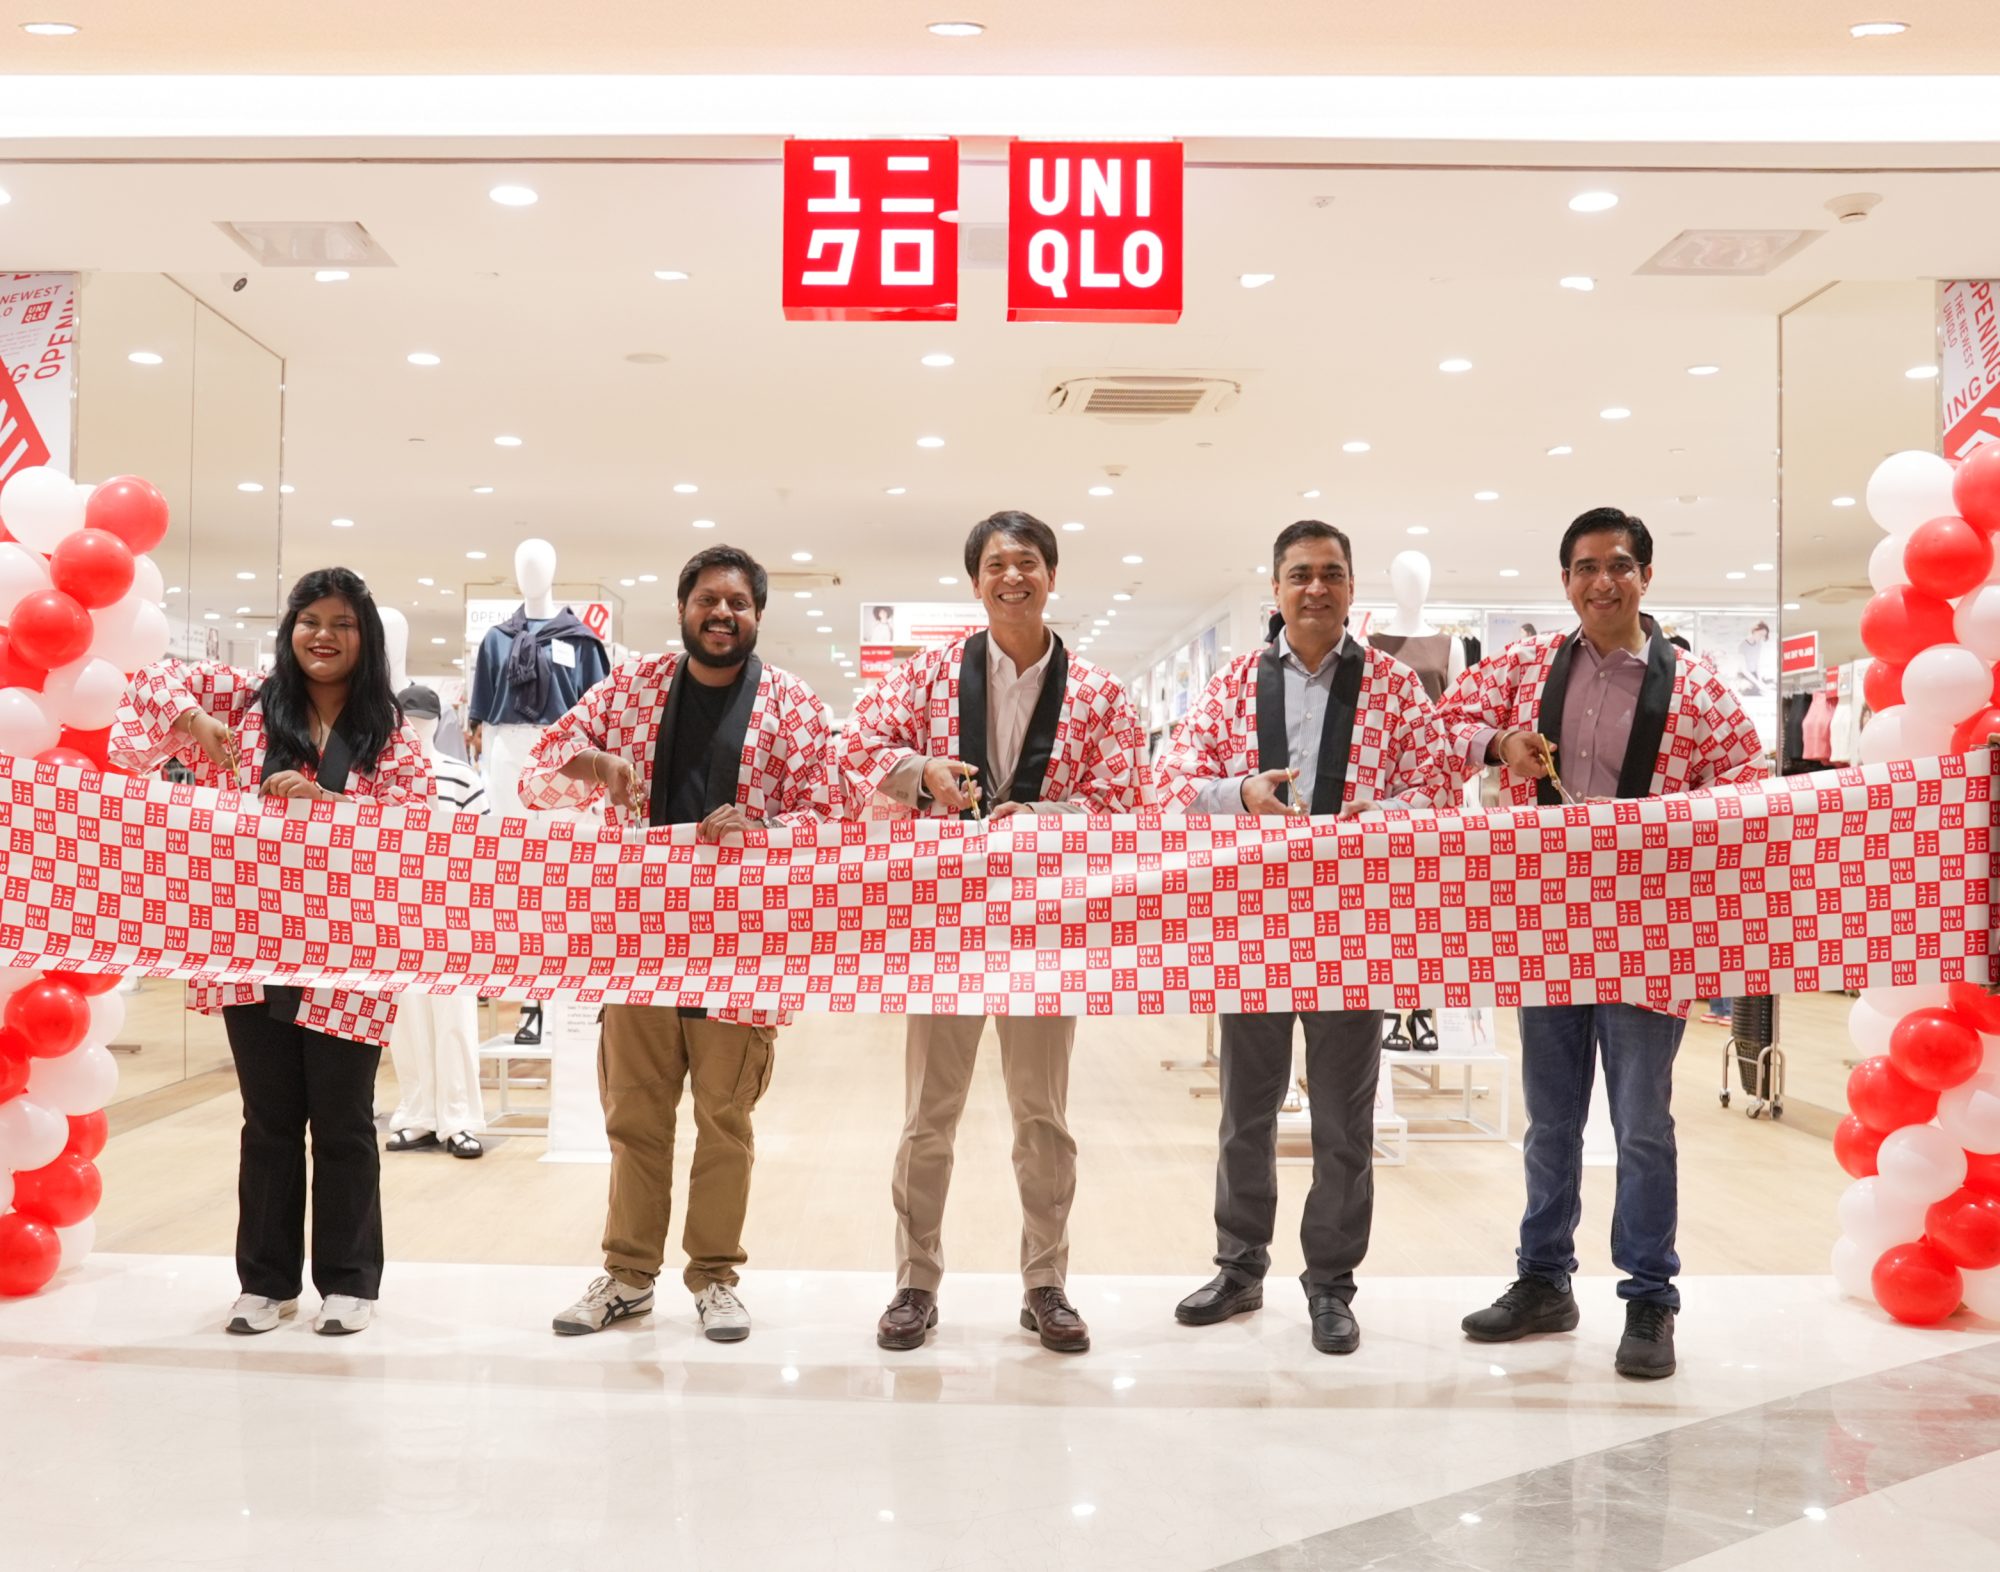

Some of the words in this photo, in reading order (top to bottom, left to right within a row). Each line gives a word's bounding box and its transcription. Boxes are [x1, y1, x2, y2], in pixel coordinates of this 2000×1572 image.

[807, 156, 935, 213] ユニ
[1028, 158, 1152, 217] UNI
[801, 229, 935, 286] クロ
[1028, 229, 1164, 298] QLO
[0, 284, 63, 305] NEWEST
[28, 303, 49, 314] UNI
[1954, 290, 1966, 319] THE
[24, 311, 46, 323] QLO
[1943, 301, 1958, 348] UNIQLO
[1959, 318, 1974, 369] NEWEST
[214, 702, 229, 710] QLO
[932, 708, 946, 716] QLO
[247, 714, 261, 722] UNI
[1365, 729, 1378, 738] UNI
[1364, 736, 1378, 746] QLO
[1674, 738, 1689, 747] UNI
[1672, 746, 1688, 756] QLO
[1358, 775, 1373, 784] QLO
[1968, 778, 1986, 789] ユニ
[58, 790, 75, 801] ユニ
[1870, 786, 1889, 796] ユニ
[1967, 789, 1986, 800] クロ
[57, 800, 75, 811] クロ
[1870, 796, 1890, 807] クロ
[147, 804, 165, 814] ユニ
[146, 814, 164, 825] クロ
[1796, 817, 1814, 827] UNI
[285, 821, 304, 831] ユニ
[843, 824, 861, 833] UNI
[1644, 826, 1663, 835] UNI
[284, 830, 303, 841] クロ
[381, 830, 399, 840] ユニ
[1593, 828, 1612, 837] UNI
[1795, 827, 1814, 838] QLO
[1967, 830, 1985, 840] ユニ
[213, 836, 230, 846] UNI
[844, 834, 863, 844] QLO
[1340, 836, 1358, 846] UNI
[1442, 834, 1460, 842] UNI
[1594, 838, 1614, 848] QLO
[1645, 836, 1665, 847] QLO
[379, 840, 398, 850] クロ
[1442, 844, 1462, 854] QLO
[1967, 841, 1986, 851] クロ
[213, 846, 232, 857] QLO
[1341, 846, 1360, 857] QLO
[989, 854, 1008, 863] UNI
[1519, 856, 1537, 866] ユニ
[498, 863, 516, 872] UNI
[644, 865, 662, 874] UNI
[989, 865, 1009, 875] QLO
[1266, 865, 1284, 875] ユニ
[1892, 861, 1910, 870] UNI
[79, 866, 96, 877] UNI
[1518, 867, 1538, 877] クロ
[1893, 871, 1912, 882] QLO
[78, 877, 97, 887] QLO
[497, 872, 517, 883] QLO
[643, 875, 663, 885] QLO
[1265, 876, 1285, 886] クロ
[1693, 873, 1710, 883] UNI
[8, 878, 26, 889] ユニ
[915, 881, 934, 891] ユニ
[1593, 879, 1611, 888] UNI
[1967, 881, 1985, 892] ユニ
[6, 888, 25, 900] クロ
[569, 889, 587, 899] ユニ
[815, 886, 834, 896] ユニ
[1692, 883, 1712, 895] QLO
[260, 890, 277, 900] UNI
[914, 892, 934, 902] クロ
[1190, 895, 1208, 904] UNI
[1593, 889, 1613, 900] QLO
[1819, 890, 1838, 900] ユニ
[1966, 892, 1986, 902] クロ
[261, 900, 279, 910] QLO
[568, 900, 587, 909] クロ
[815, 896, 835, 905] クロ
[1089, 900, 1107, 909] UNI
[400, 905, 417, 915] UNI
[1190, 905, 1209, 916] QLO
[1819, 901, 1839, 911] クロ
[192, 906, 209, 917] ユニ
[741, 912, 759, 921] UNI
[1089, 910, 1108, 921] QLO
[1418, 910, 1437, 920] ユニ
[1893, 912, 1911, 921] UNI
[191, 917, 209, 927] クロ
[400, 915, 420, 925] QLO
[1317, 913, 1336, 923] ユニ
[121, 922, 138, 933] UNI
[331, 922, 349, 932] ユニ
[741, 921, 761, 931] QLO
[1317, 924, 1336, 934] クロ
[1418, 921, 1438, 930] クロ
[1695, 924, 1713, 933] UNI
[1894, 922, 1913, 933] QLO
[120, 932, 139, 943] QLO
[331, 932, 350, 942] クロ
[864, 932, 882, 941] ユニ
[964, 929, 982, 938] ユニ
[1545, 932, 1563, 941] UNI
[620, 936, 637, 945] ユニ
[962, 939, 982, 949] クロ
[1696, 934, 1716, 945] QLO
[618, 946, 638, 955] クロ
[862, 941, 882, 951] クロ
[1546, 942, 1565, 953] QLO
[1772, 945, 1790, 955] ユニ
[1623, 953, 1641, 963] ユニ
[1771, 955, 1791, 966] クロ
[1623, 964, 1642, 974] クロ
[1942, 960, 1960, 969] UNI
[1217, 967, 1236, 976] ユニ
[1268, 965, 1287, 975] ユニ
[1845, 966, 1863, 976] UNI
[1268, 976, 1288, 985] クロ
[1698, 975, 1716, 985] UNI
[1942, 970, 1962, 981] QLO
[1217, 977, 1237, 986] クロ
[1845, 976, 1865, 988] QLO
[236, 985, 249, 993] UNI
[1345, 988, 1364, 997] UNI
[1498, 985, 1516, 994] UNI
[1698, 986, 1718, 997] QLO
[237, 992, 251, 1002] QLO
[1140, 993, 1159, 1002] UNI
[1498, 995, 1518, 1005] QLO
[1141, 1003, 1161, 1013] QLO
[1346, 998, 1366, 1009] QLO
[311, 1007, 325, 1016] UNI
[309, 1015, 325, 1024] QLO
